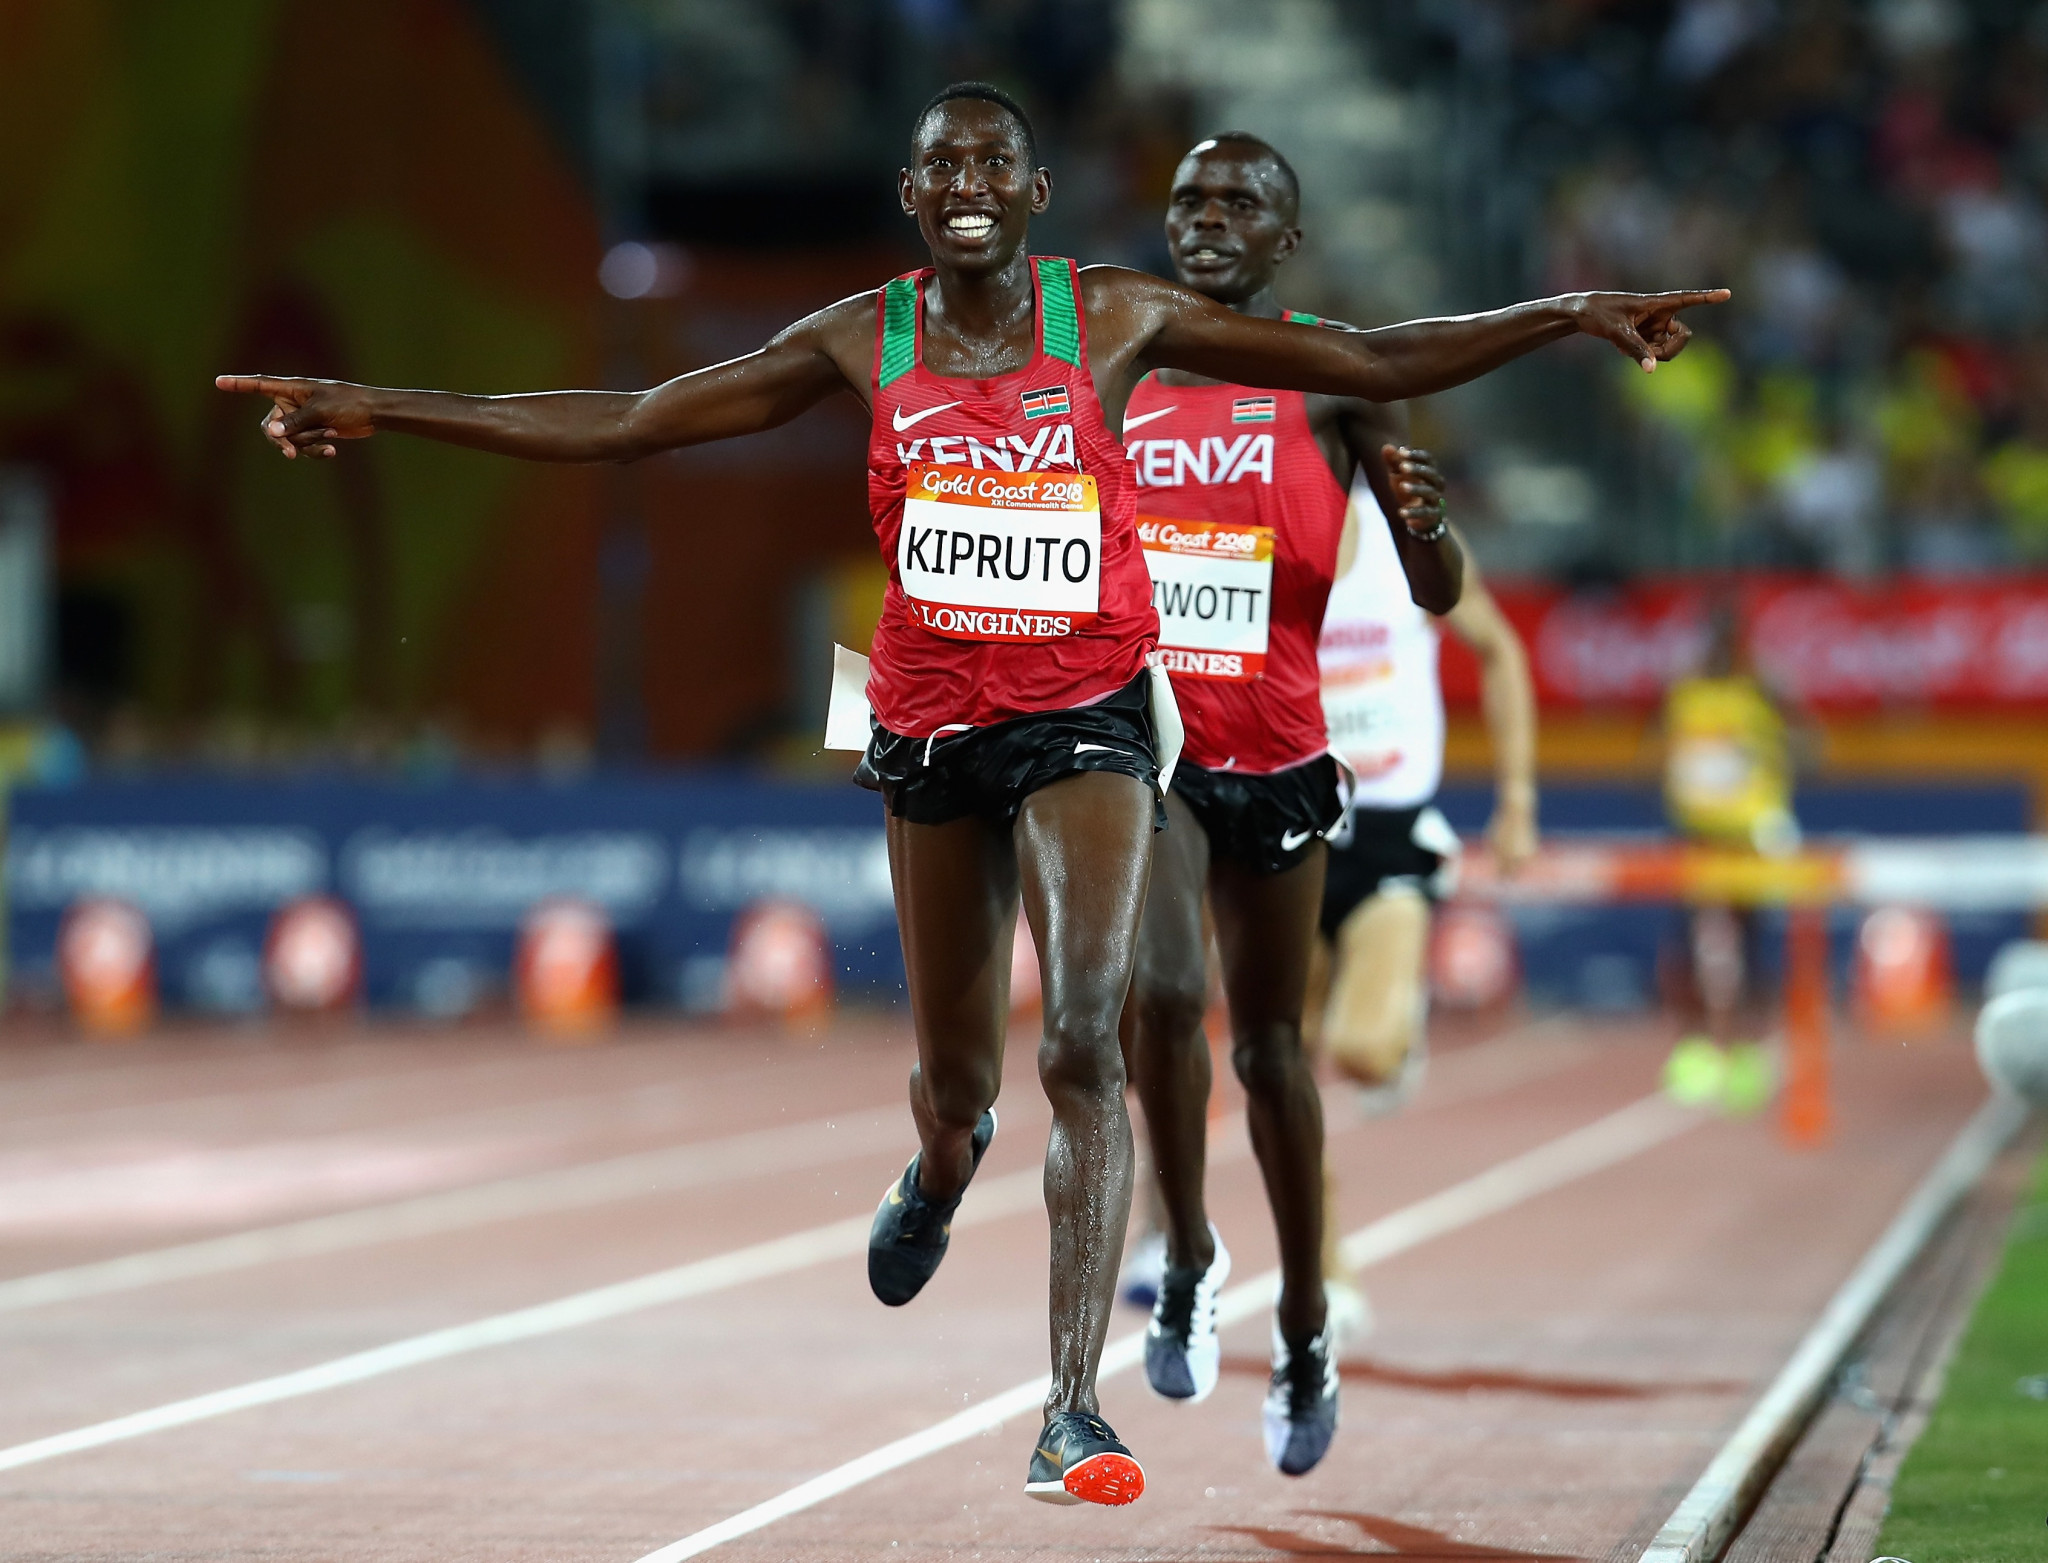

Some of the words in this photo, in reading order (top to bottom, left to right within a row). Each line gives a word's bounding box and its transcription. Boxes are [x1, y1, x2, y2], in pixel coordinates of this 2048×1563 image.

[923, 471, 974, 496] Gold
[977, 477, 1038, 501] Coast
[1040, 482, 1084, 503] 2018
[991, 499, 1005, 507] XXI
[1005, 500, 1060, 509] Commonwealth
[1060, 502, 1084, 510] Games
[906, 526, 1092, 583] KIPRUTO
[1159, 524, 1211, 548] Coast
[1213, 532, 1257, 553] 2018
[921, 604, 1072, 637] LONGINES
